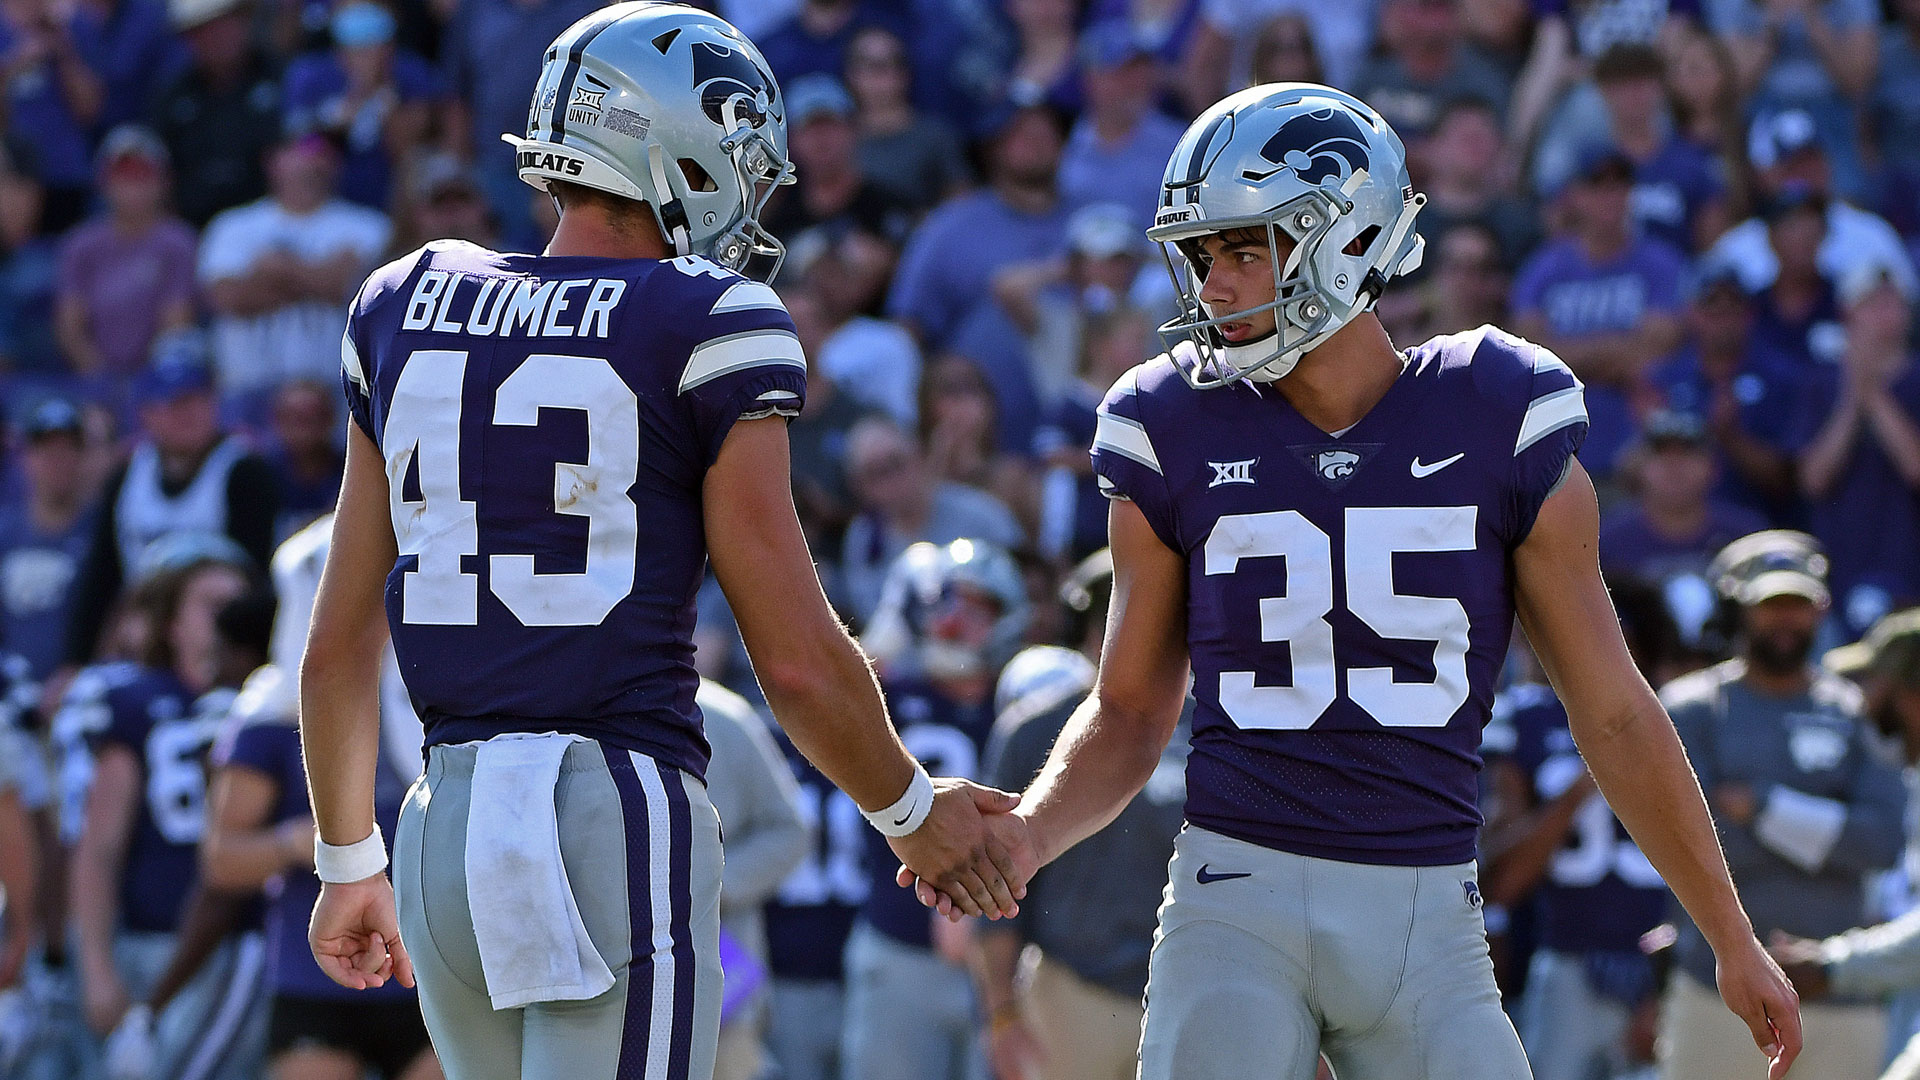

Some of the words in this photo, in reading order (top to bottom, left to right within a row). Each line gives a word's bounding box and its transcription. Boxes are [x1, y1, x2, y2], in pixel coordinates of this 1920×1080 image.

[568, 108, 601, 127] UNITY
[402, 271, 627, 338] BLUMER
[383, 350, 638, 626] 43
[1204, 505, 1478, 730] 35
